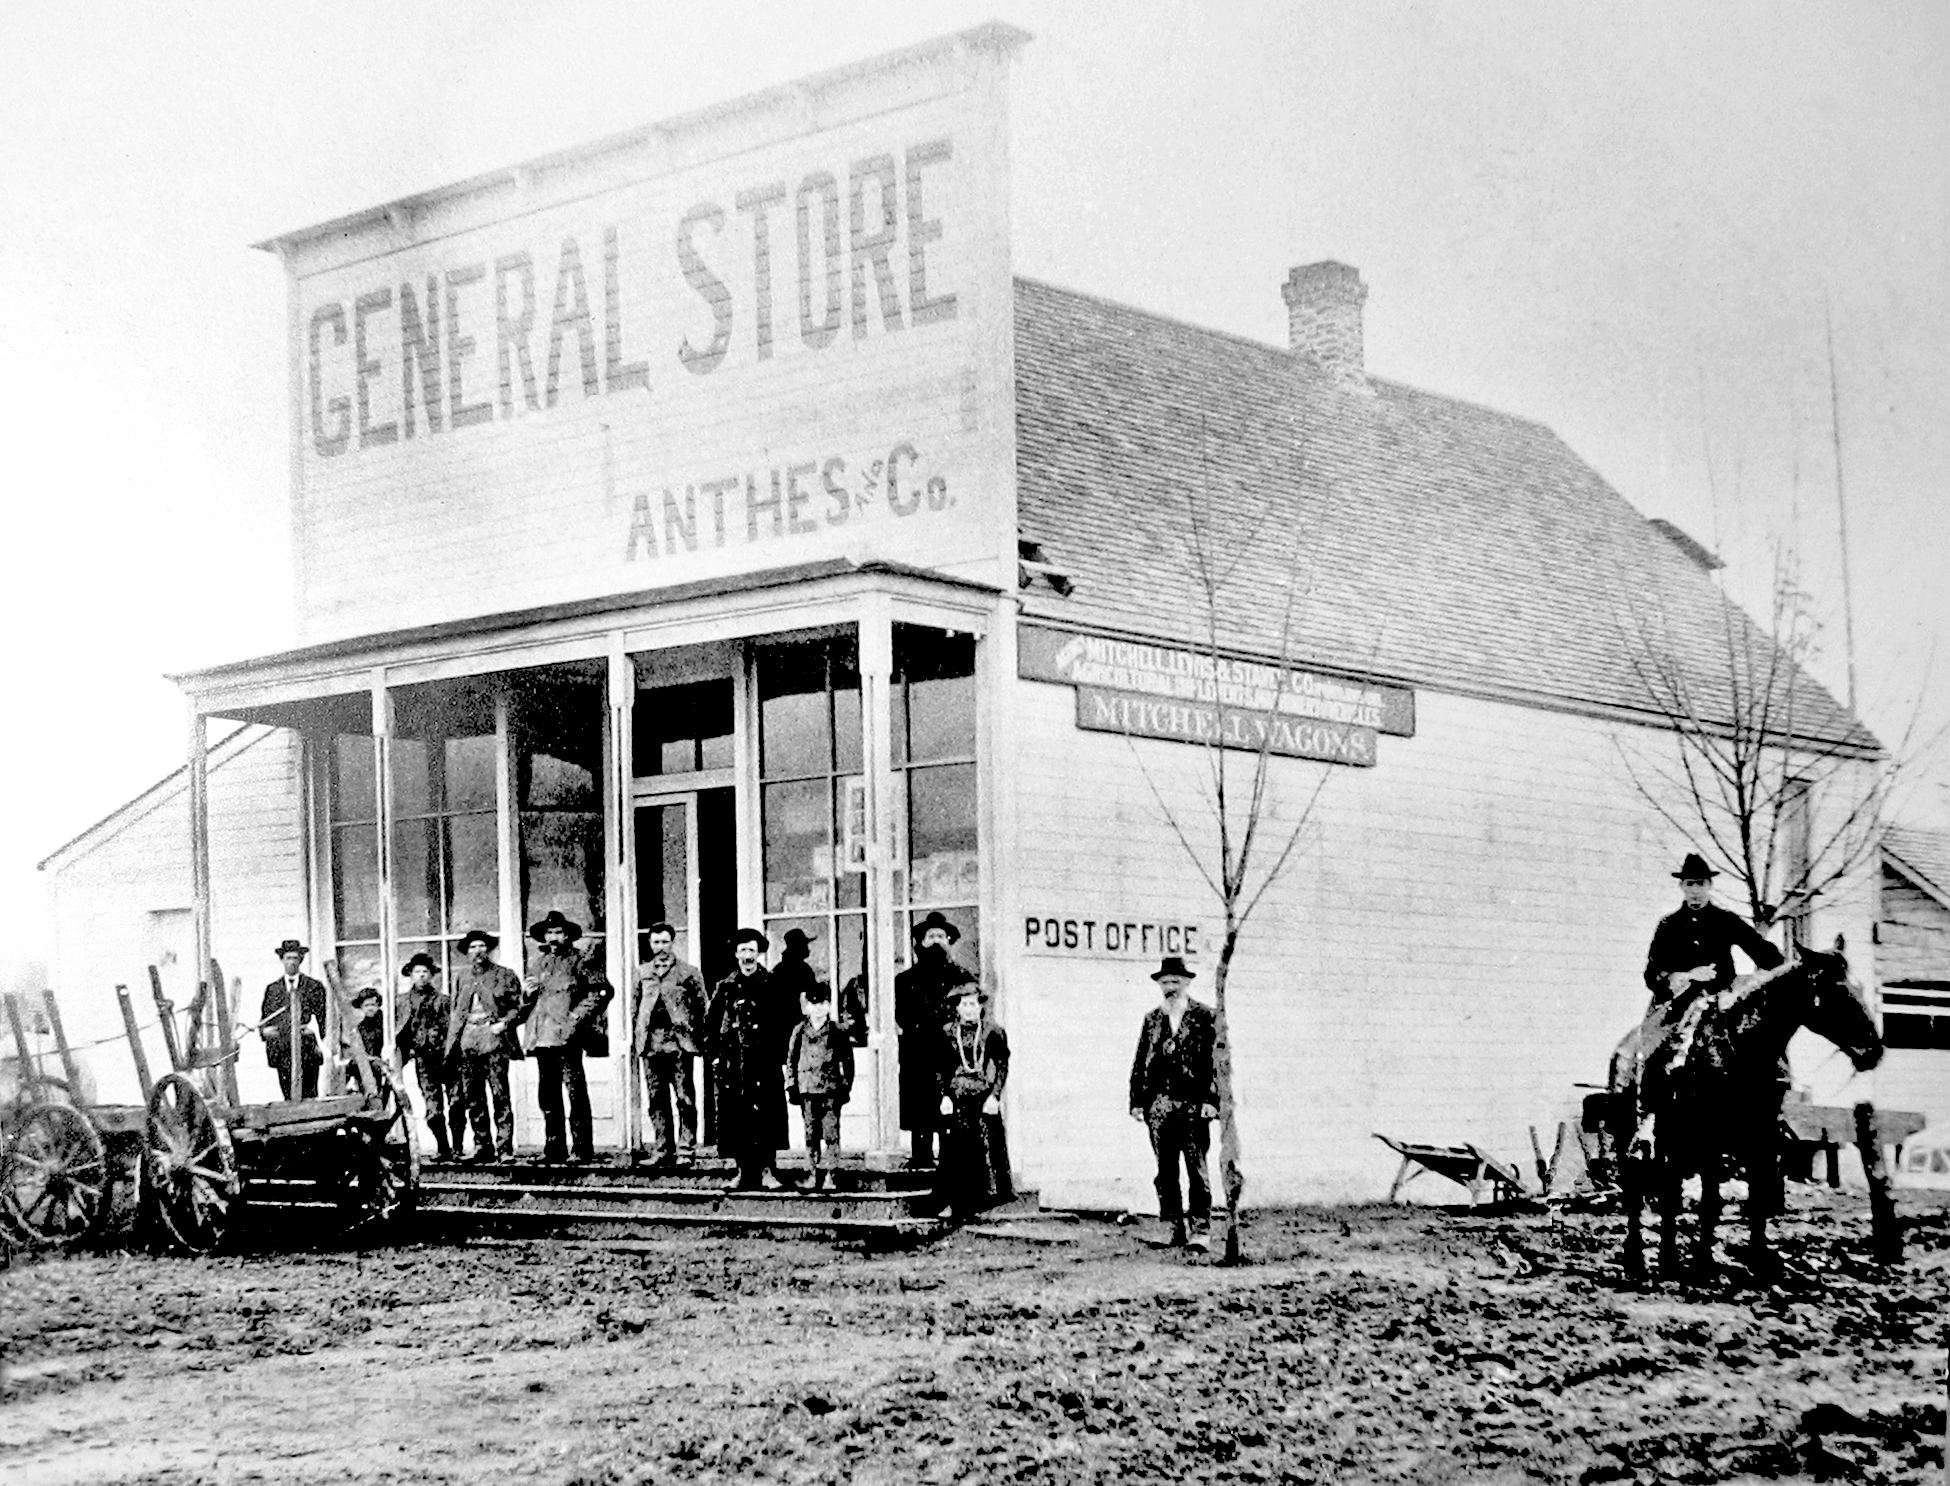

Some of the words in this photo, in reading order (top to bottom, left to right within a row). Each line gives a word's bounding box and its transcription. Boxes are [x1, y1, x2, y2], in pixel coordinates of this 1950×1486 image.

[309, 225, 651, 457] GENERAL
[677, 137, 957, 376] STORE
[624, 457, 851, 562] ANTHES
[1025, 917, 1096, 949] POST
[1105, 922, 1198, 955] OFFICE
